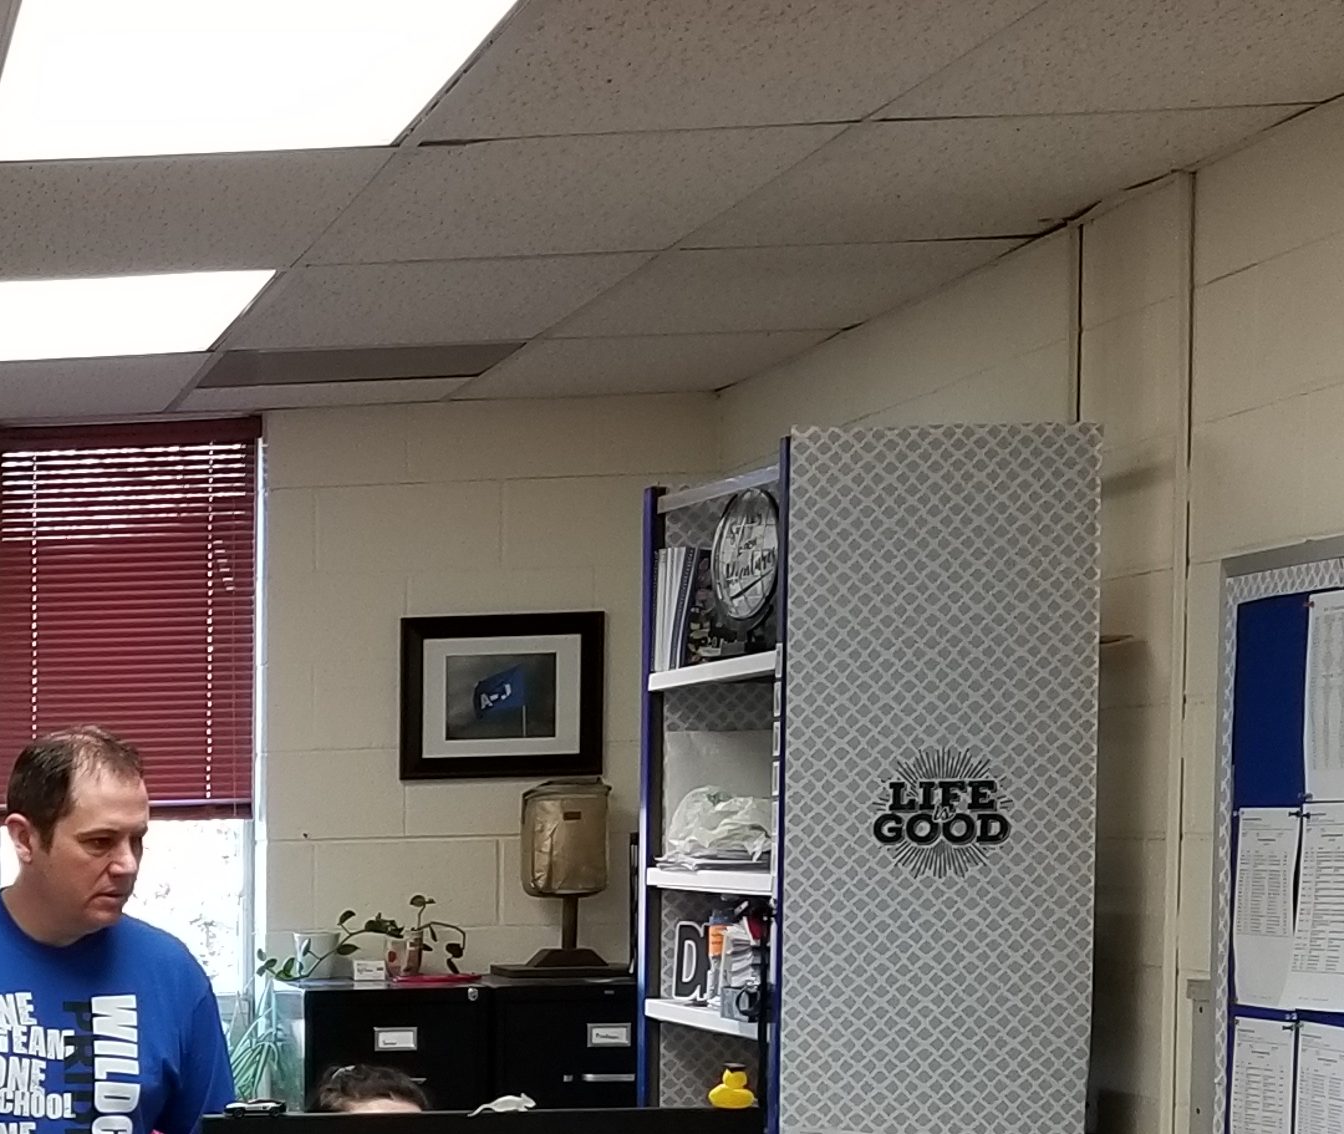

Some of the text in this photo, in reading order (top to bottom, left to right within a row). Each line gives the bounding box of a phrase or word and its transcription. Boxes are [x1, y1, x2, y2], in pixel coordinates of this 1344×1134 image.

[889, 780, 997, 813] LIFE
[933, 801, 957, 821] is
[873, 812, 1011, 845] GOOD
